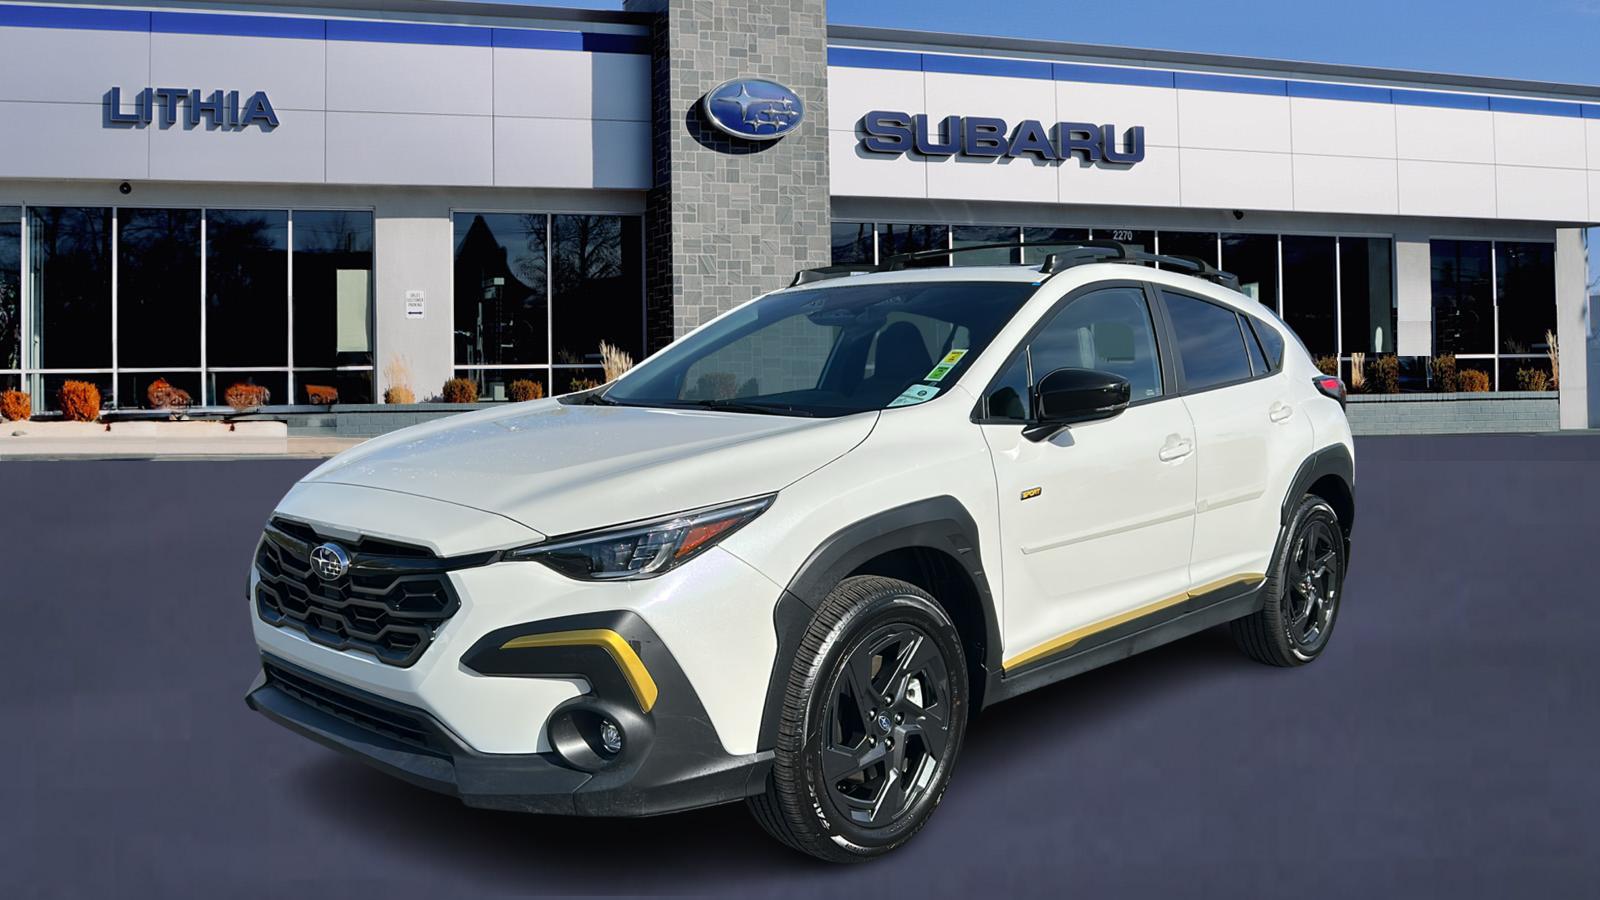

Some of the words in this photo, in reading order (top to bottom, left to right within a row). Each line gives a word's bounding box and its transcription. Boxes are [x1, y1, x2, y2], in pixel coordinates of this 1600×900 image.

[107, 86, 280, 129] LITHIA
[858, 109, 1146, 166] SUBARU
[1112, 229, 1133, 241] 2270
[1022, 487, 1041, 499] SPORT
